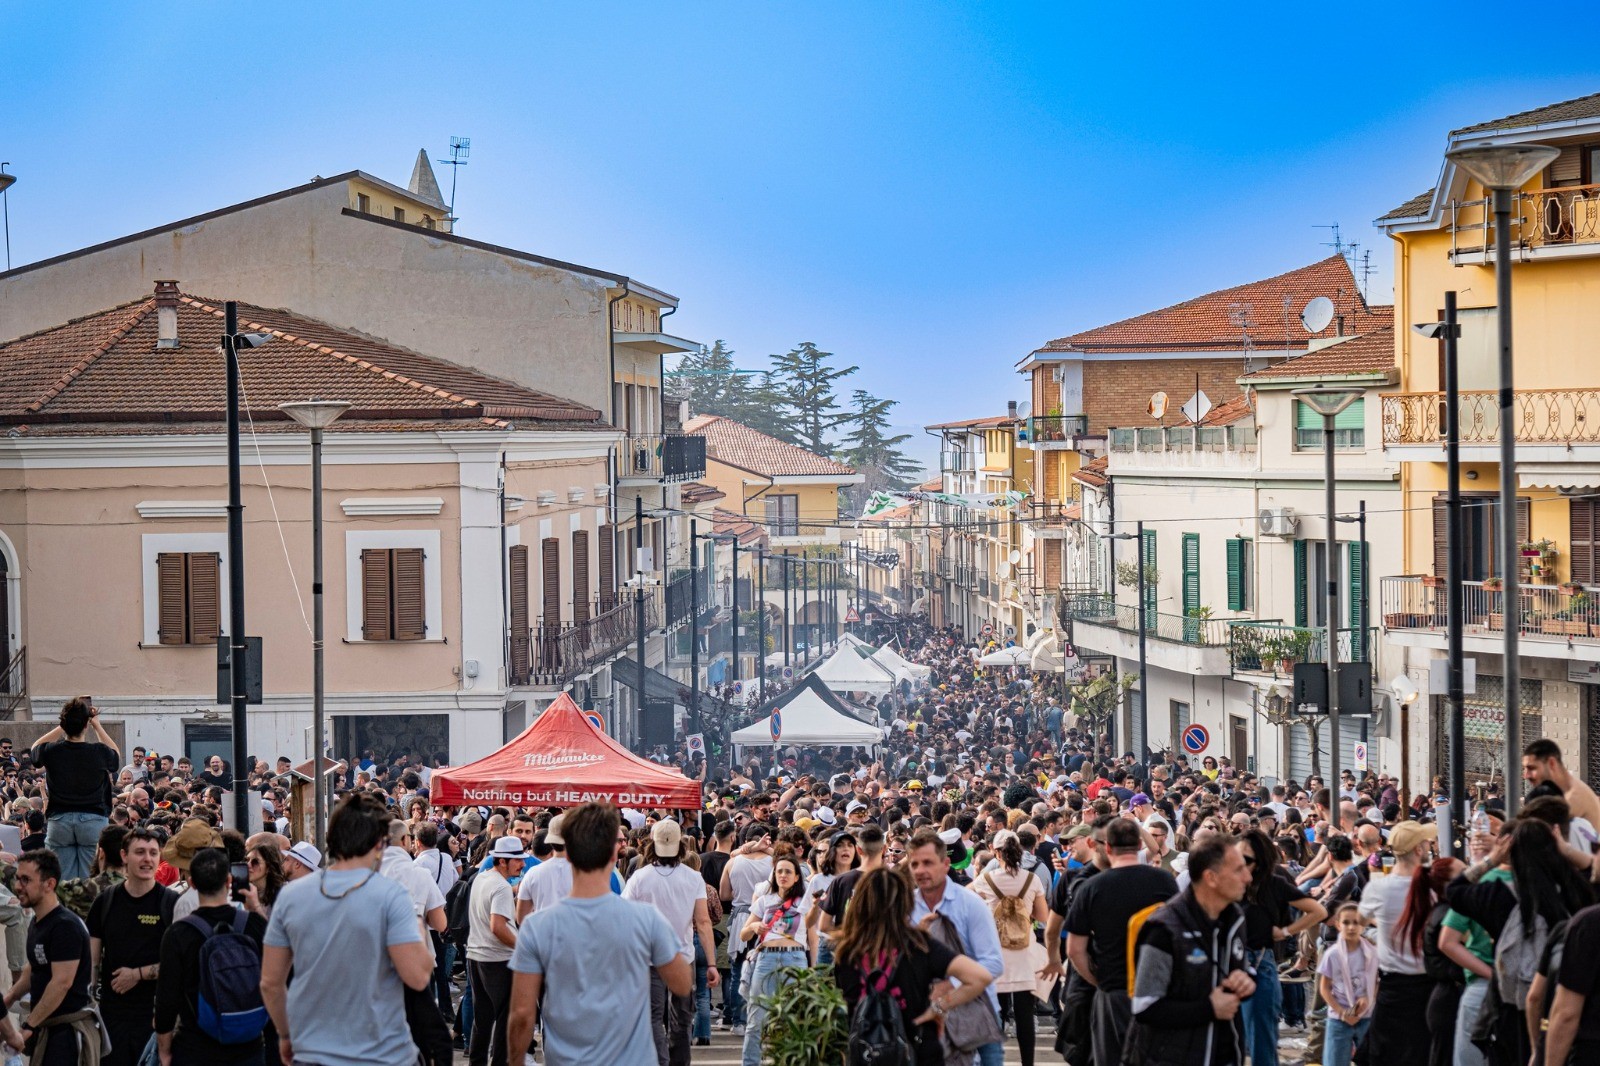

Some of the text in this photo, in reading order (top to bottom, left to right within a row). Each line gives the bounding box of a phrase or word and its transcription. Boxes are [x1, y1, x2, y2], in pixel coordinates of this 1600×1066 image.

[523, 752, 605, 767] Milwaukee
[463, 788, 522, 803] Nothing
[527, 790, 552, 801] but
[556, 791, 614, 804] HEAVY
